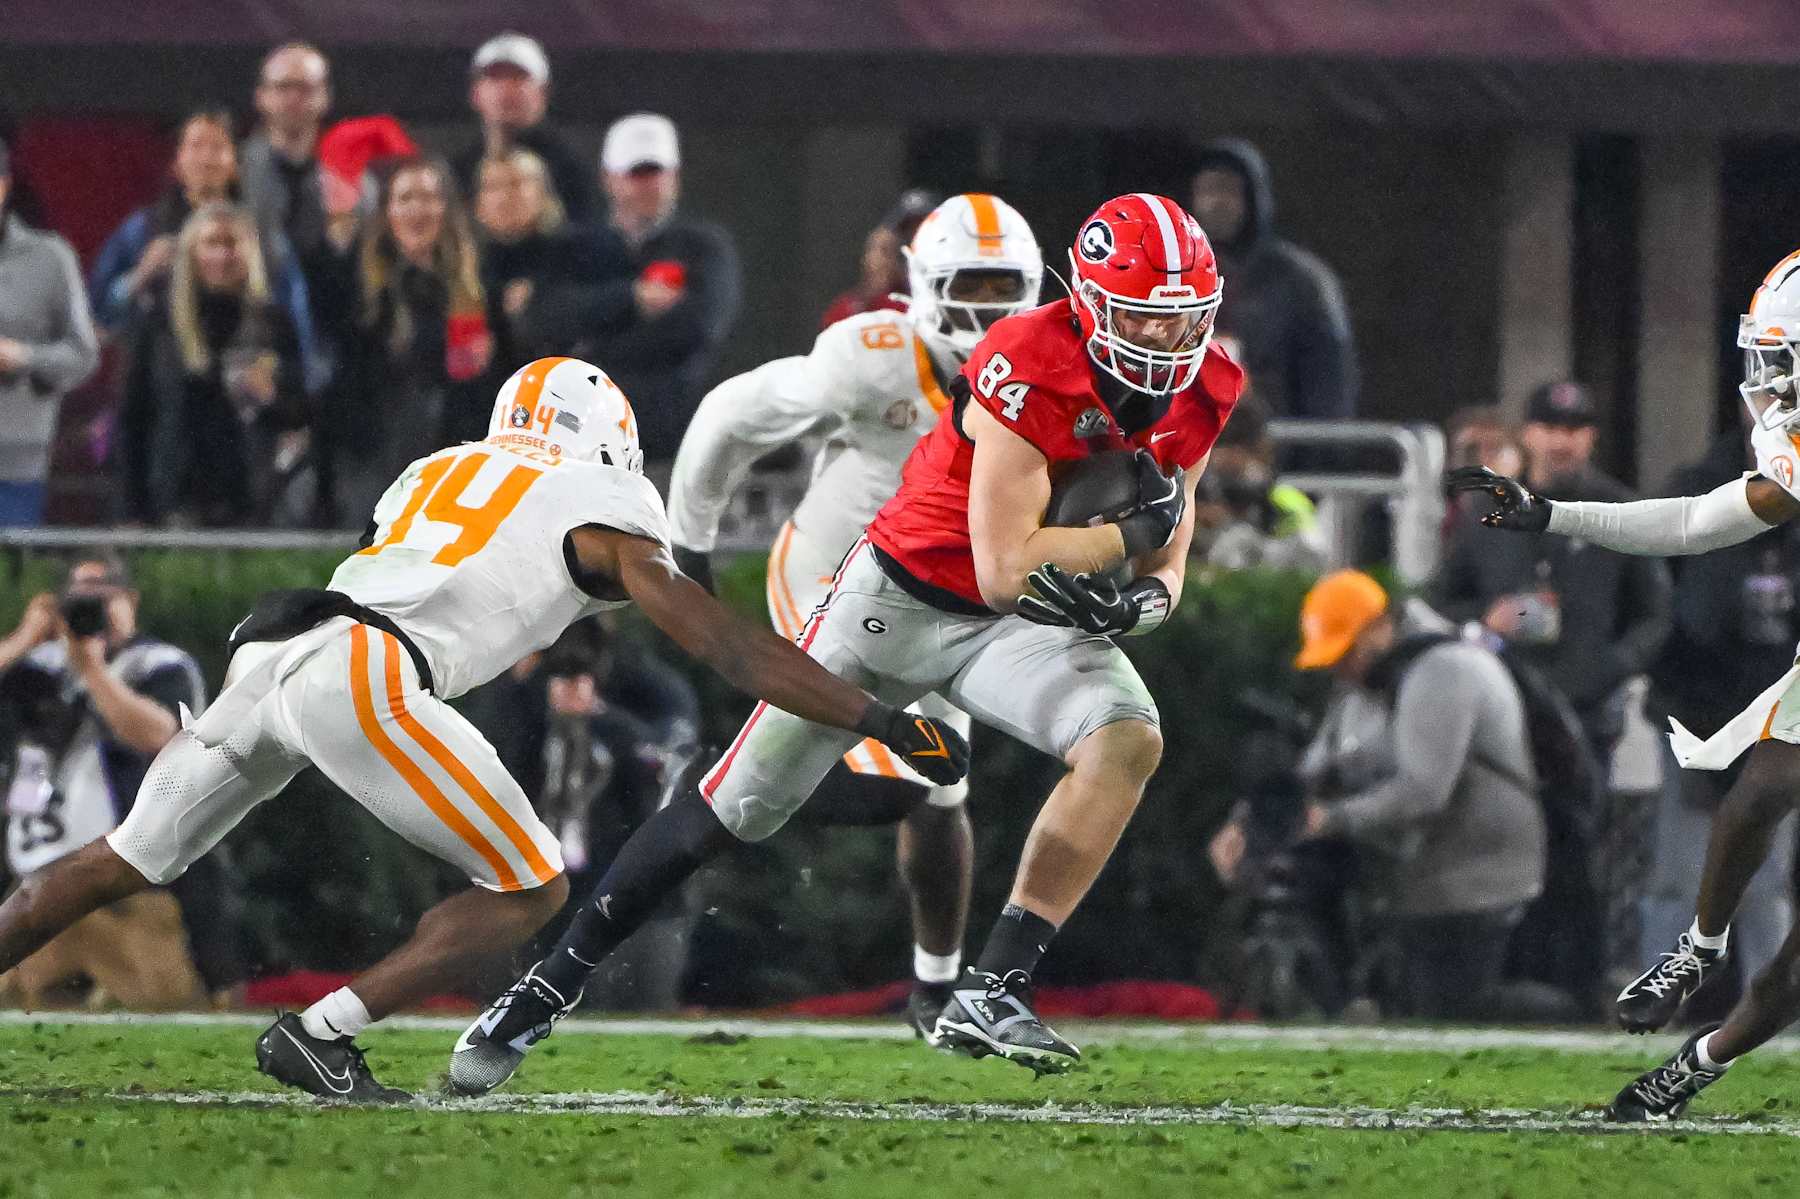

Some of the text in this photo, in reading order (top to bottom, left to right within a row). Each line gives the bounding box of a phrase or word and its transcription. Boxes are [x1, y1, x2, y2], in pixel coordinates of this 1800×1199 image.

[1080, 220, 1115, 262] G
[861, 322, 905, 351] 19
[977, 351, 1030, 421] 84
[355, 452, 544, 567] 14
[863, 617, 887, 634] G
